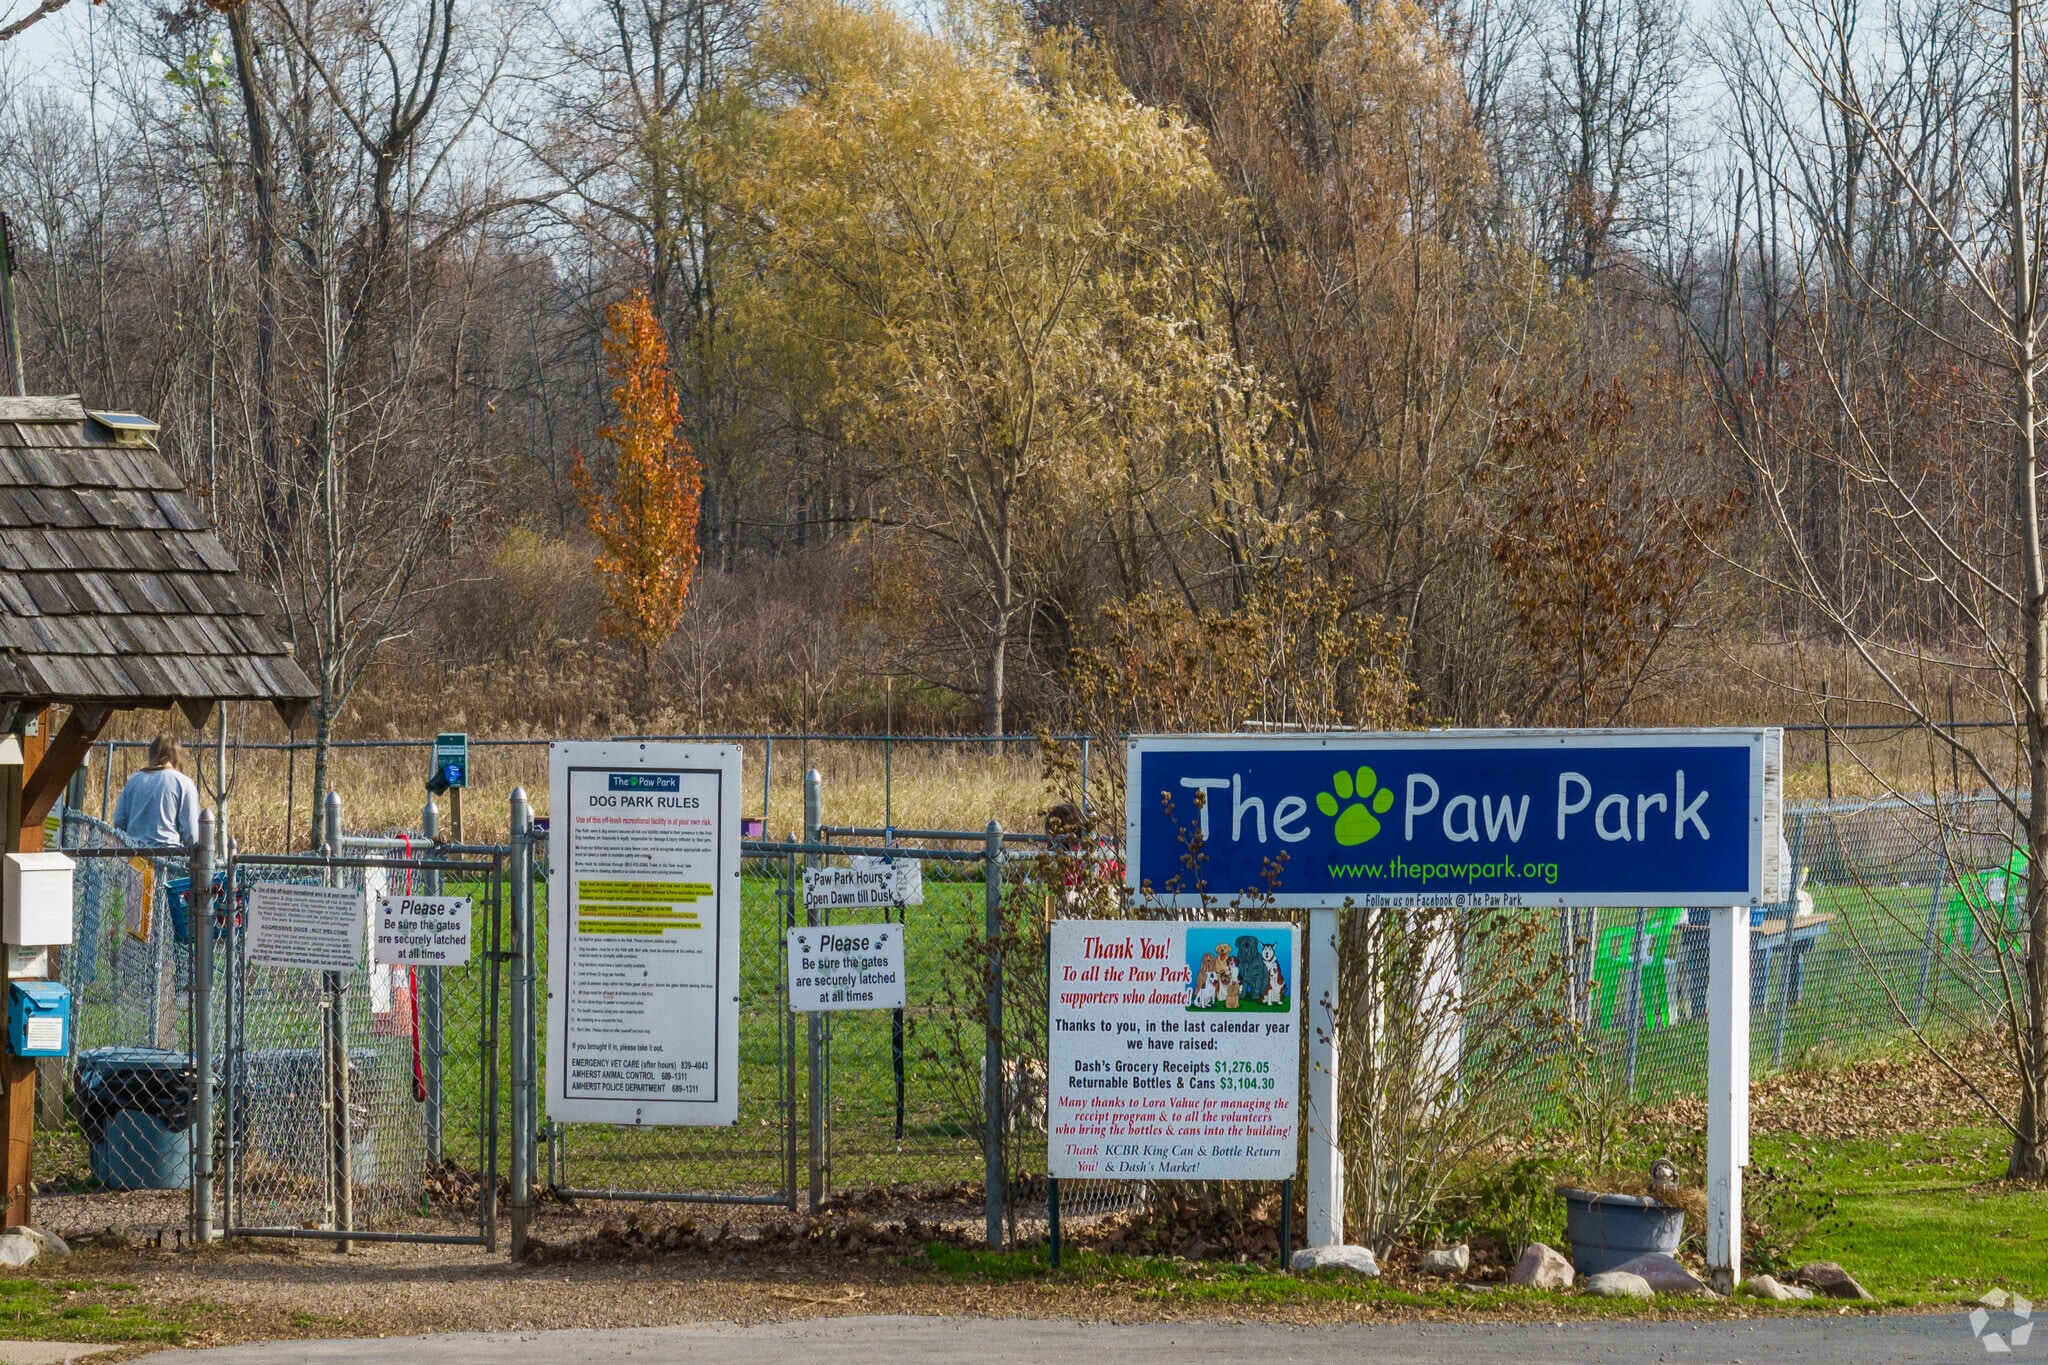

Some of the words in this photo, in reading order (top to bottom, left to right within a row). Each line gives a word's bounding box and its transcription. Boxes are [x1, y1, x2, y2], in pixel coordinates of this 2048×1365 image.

[613, 777, 629, 786] The
[639, 777, 654, 786] Paw
[657, 777, 675, 786] Park
[590, 796, 617, 807] DOG
[621, 796, 653, 807] PARK
[658, 797, 699, 808] RULES
[1180, 774, 1310, 842] The
[1405, 774, 1529, 842] Paw
[1558, 771, 1709, 841] Park
[1329, 856, 1558, 884] www.thepawpark.org
[814, 873, 832, 886] Paw
[834, 872, 854, 885] Park
[857, 872, 884, 884] Hours
[806, 892, 828, 905] Open
[831, 891, 855, 904] Dawn
[857, 890, 868, 903] till
[871, 890, 895, 903] Dusk
[1366, 894, 1390, 907] Follow
[1393, 897, 1402, 907] us
[1405, 897, 1414, 906] on
[1417, 894, 1453, 906] Facebook
[1456, 894, 1465, 907] @
[1468, 894, 1482, 906] The
[1485, 894, 1500, 906] Paw
[1504, 894, 1522, 907] Park
[401, 900, 445, 917] Please
[384, 919, 396, 929] Be
[398, 919, 417, 931] sure
[420, 920, 434, 930] the
[436, 920, 460, 932] gates
[378, 936, 392, 944] are
[394, 934, 431, 946] securely
[434, 934, 466, 945] latched
[820, 935, 869, 952] Please
[398, 949, 406, 958] at
[409, 949, 421, 959] all
[421, 949, 445, 959] times
[1084, 937, 1133, 959] Thank
[1140, 938, 1170, 959] You!
[802, 958, 815, 969] Be
[818, 960, 840, 969] sure
[843, 957, 858, 968] the
[862, 957, 888, 969] gates
[796, 978, 812, 987] are
[815, 974, 856, 987] securely
[860, 972, 895, 984] latched
[1064, 966, 1077, 981] To
[1081, 966, 1100, 981] all
[1104, 966, 1124, 981] the
[1128, 967, 1156, 982] Paw
[1160, 966, 1191, 982] Park
[820, 992, 829, 1003] at
[832, 991, 845, 1002] all
[846, 991, 873, 1002] times
[1060, 992, 1118, 1009] supporters
[1123, 989, 1145, 1004] who
[1149, 989, 1191, 1005] donate!
[1055, 1019, 1095, 1031] Thanks
[1101, 1020, 1112, 1032] to
[1117, 1022, 1140, 1035] you,
[1146, 1020, 1156, 1032] in
[1161, 1020, 1179, 1032] the
[1184, 1020, 1205, 1032] last
[1210, 1020, 1260, 1033] calendar
[1266, 1024, 1290, 1036] year
[587, 1043, 607, 1051] brought
[620, 1044, 636, 1052] please
[1127, 1040, 1143, 1049] we
[1148, 1038, 1174, 1050] have
[1179, 1038, 1218, 1050] raised:
[572, 1059, 609, 1067] EMERGENCY
[610, 1060, 622, 1068] VET
[623, 1060, 640, 1068] CARE
[641, 1060, 656, 1069] (after
[658, 1061, 676, 1070] hours)
[681, 1061, 708, 1070] 839-4043
[1075, 1060, 1110, 1072] Dash's
[1116, 1060, 1158, 1075] Grocery
[1163, 1061, 1210, 1075] Receipts
[1215, 1061, 1269, 1074] $1,276.05
[602, 1071, 624, 1079] ANIMAL
[626, 1072, 655, 1080] CONTROL
[661, 1072, 687, 1080] 689-1311
[602, 1083, 624, 1091] POLICE
[625, 1084, 665, 1092] DEPARTMENT
[672, 1085, 698, 1093] 689-1311
[1069, 1077, 1128, 1088] Returnable
[1133, 1077, 1171, 1089] Bottles
[1177, 1077, 1184, 1089] &
[1190, 1077, 1215, 1089] Cans
[1220, 1077, 1274, 1091] $3,104.30
[1058, 1097, 1087, 1109] Many
[1091, 1097, 1125, 1107] thanks
[1129, 1099, 1139, 1108] to
[1142, 1098, 1165, 1108] Lora
[1201, 1098, 1217, 1110] for
[1221, 1099, 1270, 1111] managing
[1274, 1098, 1289, 1110] the
[1075, 1112, 1108, 1123] receipt
[1112, 1114, 1155, 1126] program
[1159, 1112, 1168, 1122] &
[1172, 1113, 1182, 1121] to
[1185, 1112, 1199, 1122] all
[1202, 1112, 1217, 1122] the
[1221, 1112, 1272, 1122] volunteers
[1055, 1126, 1075, 1135] who
[1079, 1124, 1106, 1138] bring
[1110, 1124, 1125, 1135] the
[1128, 1124, 1162, 1135] bottles
[1166, 1126, 1174, 1135] &
[1178, 1127, 1201, 1135] cans
[1204, 1125, 1224, 1136] into
[1228, 1125, 1243, 1136] the
[1246, 1125, 1291, 1140] building!
[1066, 1144, 1098, 1155] Thank
[1106, 1145, 1139, 1155] KCBR
[1144, 1145, 1169, 1159] King
[1172, 1145, 1193, 1156] Can
[1197, 1146, 1207, 1156] &
[1212, 1146, 1242, 1156] Bottle
[1246, 1146, 1280, 1156] Return
[1078, 1161, 1098, 1171] You!
[1105, 1162, 1115, 1172] &
[1119, 1162, 1155, 1172] Dash's
[1158, 1162, 1200, 1172] Market!
